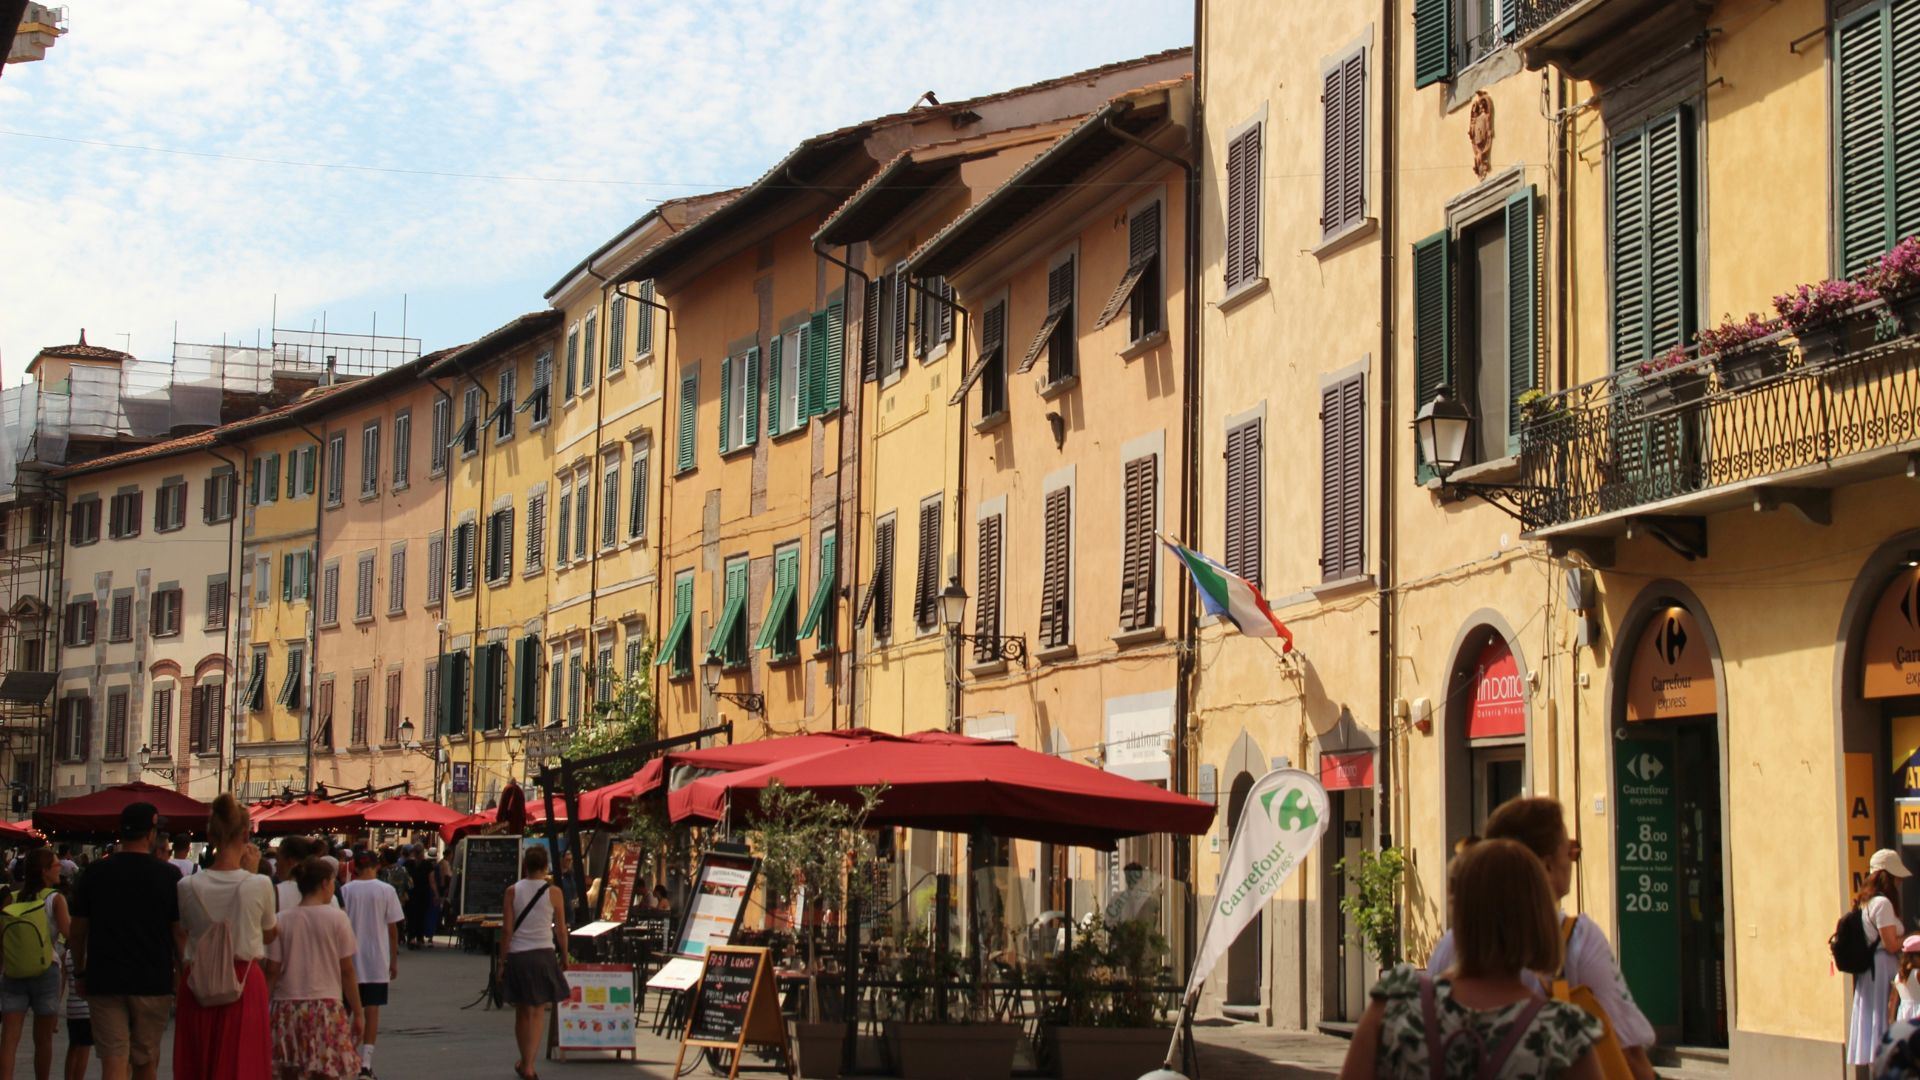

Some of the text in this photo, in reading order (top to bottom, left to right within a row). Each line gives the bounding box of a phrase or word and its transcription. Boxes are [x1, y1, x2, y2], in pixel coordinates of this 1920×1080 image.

[1651, 673, 1692, 692] Carrefour
[1657, 697, 1687, 711] express
[1622, 784, 1669, 796] Carrefour
[1629, 796, 1663, 806] express
[1638, 823, 1668, 843] 8.00
[1219, 840, 1285, 917] Carrefour
[1258, 851, 1296, 896] express
[1638, 873, 1669, 893] 9.00
